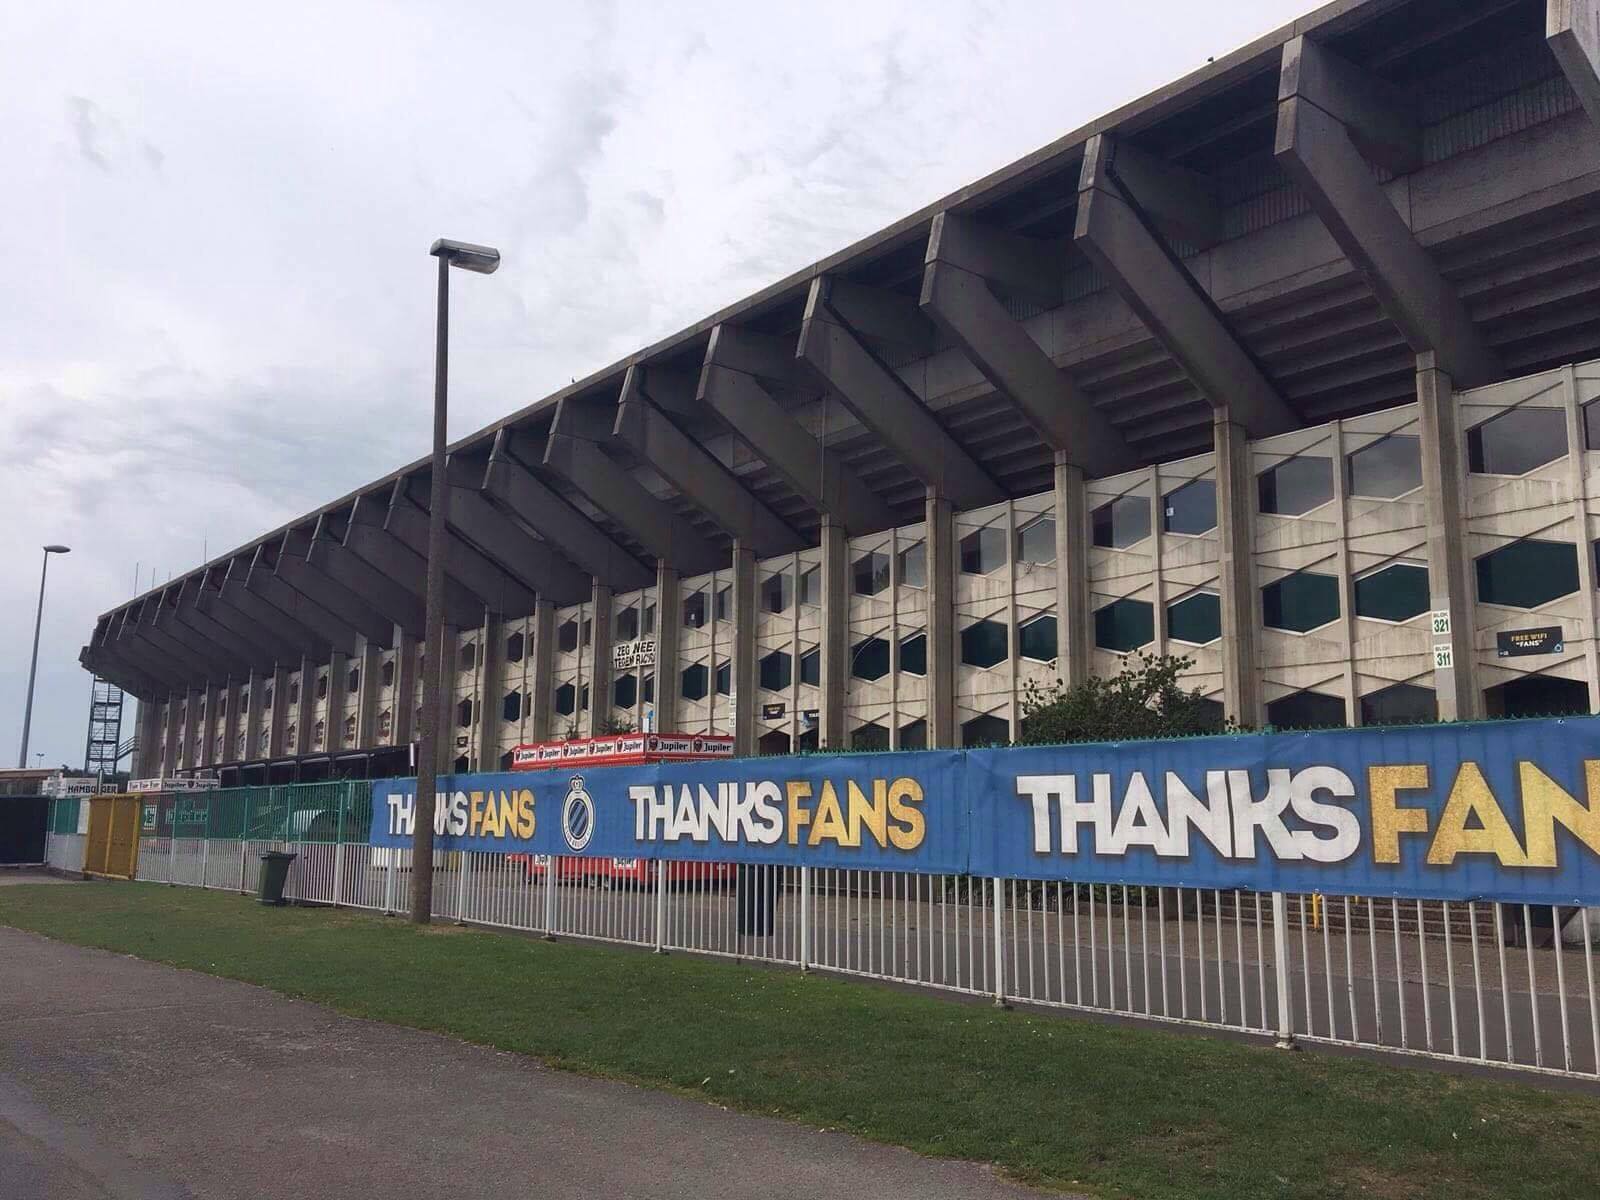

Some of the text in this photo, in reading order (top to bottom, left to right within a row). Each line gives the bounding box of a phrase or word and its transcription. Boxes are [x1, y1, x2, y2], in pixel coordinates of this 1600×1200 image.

[1434, 619, 1449, 633] 321
[1511, 632, 1548, 642] FREE WIFI
[617, 641, 656, 657] ZEG NEE
[614, 655, 634, 668] TEGEN
[1437, 652, 1451, 666] 311
[596, 743, 613, 754] Jupiler
[623, 742, 642, 752] Jupiler
[660, 742, 689, 752] Jupiler
[703, 743, 732, 752] Jupiler
[67, 783, 117, 794] HAMBUGER
[469, 789, 536, 839] FANS
[628, 777, 926, 850] THANKS FANS
[1016, 765, 1361, 863] THANKS
